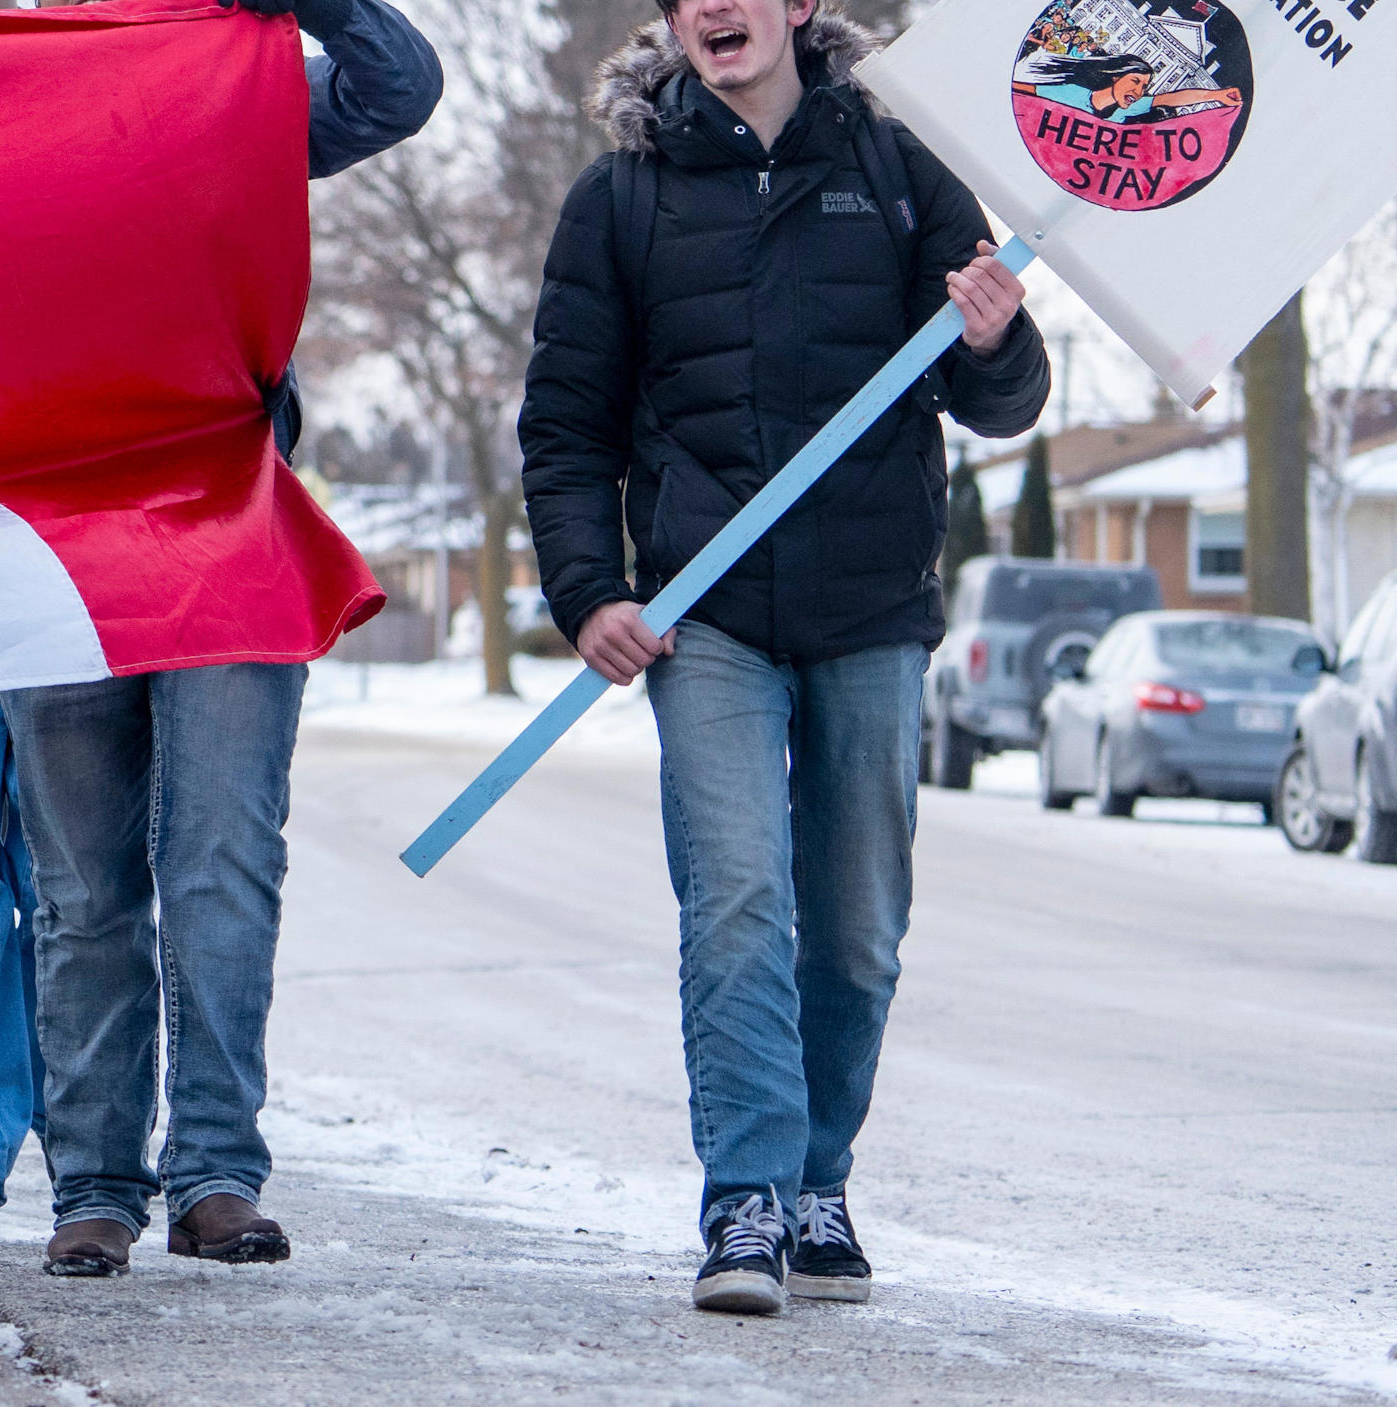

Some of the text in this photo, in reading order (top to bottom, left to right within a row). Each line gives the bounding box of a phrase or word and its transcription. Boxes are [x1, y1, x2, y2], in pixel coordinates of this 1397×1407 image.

[1036, 109, 1202, 162] HERE TO
[1066, 157, 1167, 201] STAY
[821, 192, 854, 202] EDDIE
[821, 203, 859, 213] BAUER
